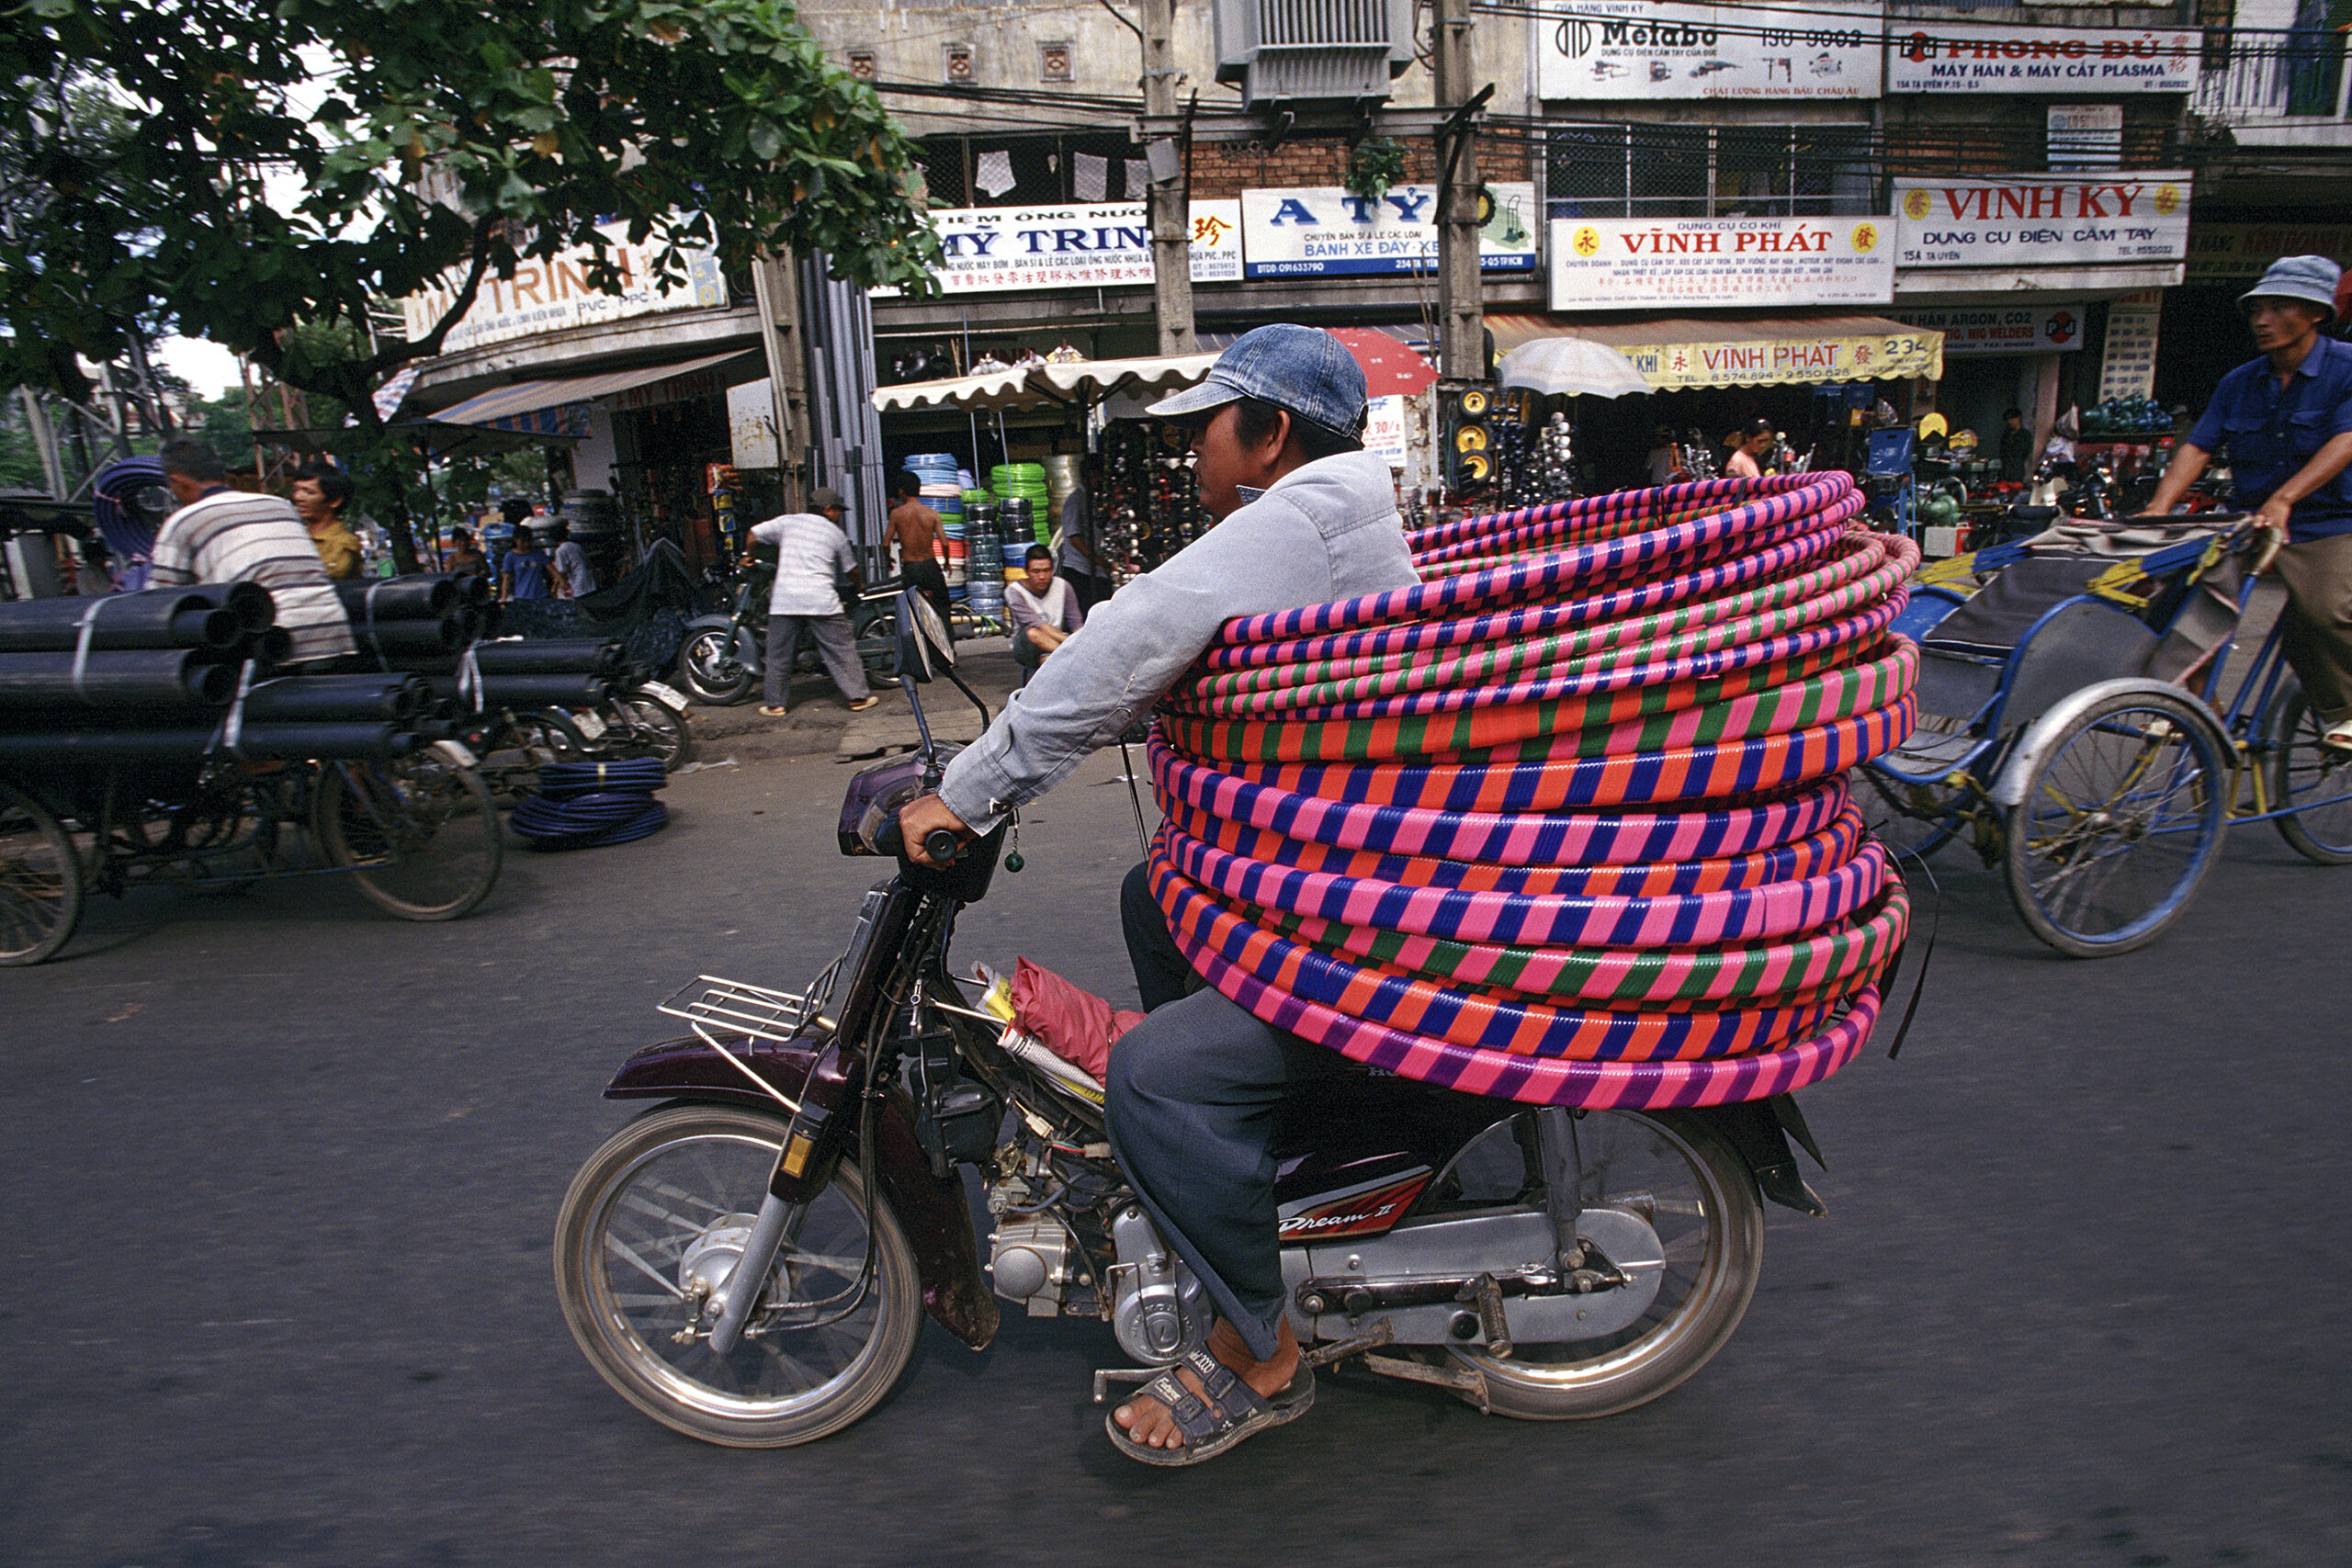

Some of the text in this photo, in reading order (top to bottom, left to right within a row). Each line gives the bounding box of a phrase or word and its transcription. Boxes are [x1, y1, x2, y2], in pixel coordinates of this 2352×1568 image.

[1606, 4, 1629, 13] VINH
[1601, 20, 1718, 47] Metabo
[1762, 29, 1792, 47] ISO
[1948, 39, 2086, 60] PHONG
[1931, 61, 1968, 76] MÁY
[2009, 64, 2022, 76] &
[2027, 62, 2061, 77] MÁY
[2102, 64, 2165, 77] PLASMA
[1942, 177, 2145, 220] VINH KÝ
[936, 213, 1002, 225] IỆM
[1089, 206, 1148, 219] NƯỚ
[1270, 198, 1319, 226] A
[1761, 220, 1781, 230] KHÍ
[2124, 227, 2159, 241] TAY
[1016, 226, 1148, 254] TRIN
[1304, 231, 1336, 242] CHUYÊN
[1577, 230, 1597, 254] 永
[1620, 222, 1834, 254] VĨNH PHÁT
[1354, 242, 1374, 255] XE
[1903, 250, 1922, 261] 15A
[577, 298, 608, 314] PVC
[618, 291, 650, 308] PPC
[2006, 312, 2031, 323] CO2
[1990, 326, 2035, 340] WELDERS
[1636, 348, 1660, 373] KHÍ
[1671, 350, 1689, 372] 永
[1702, 340, 1840, 371] VĨNH PHÁT
[1278, 1202, 1397, 1234] Dream II
